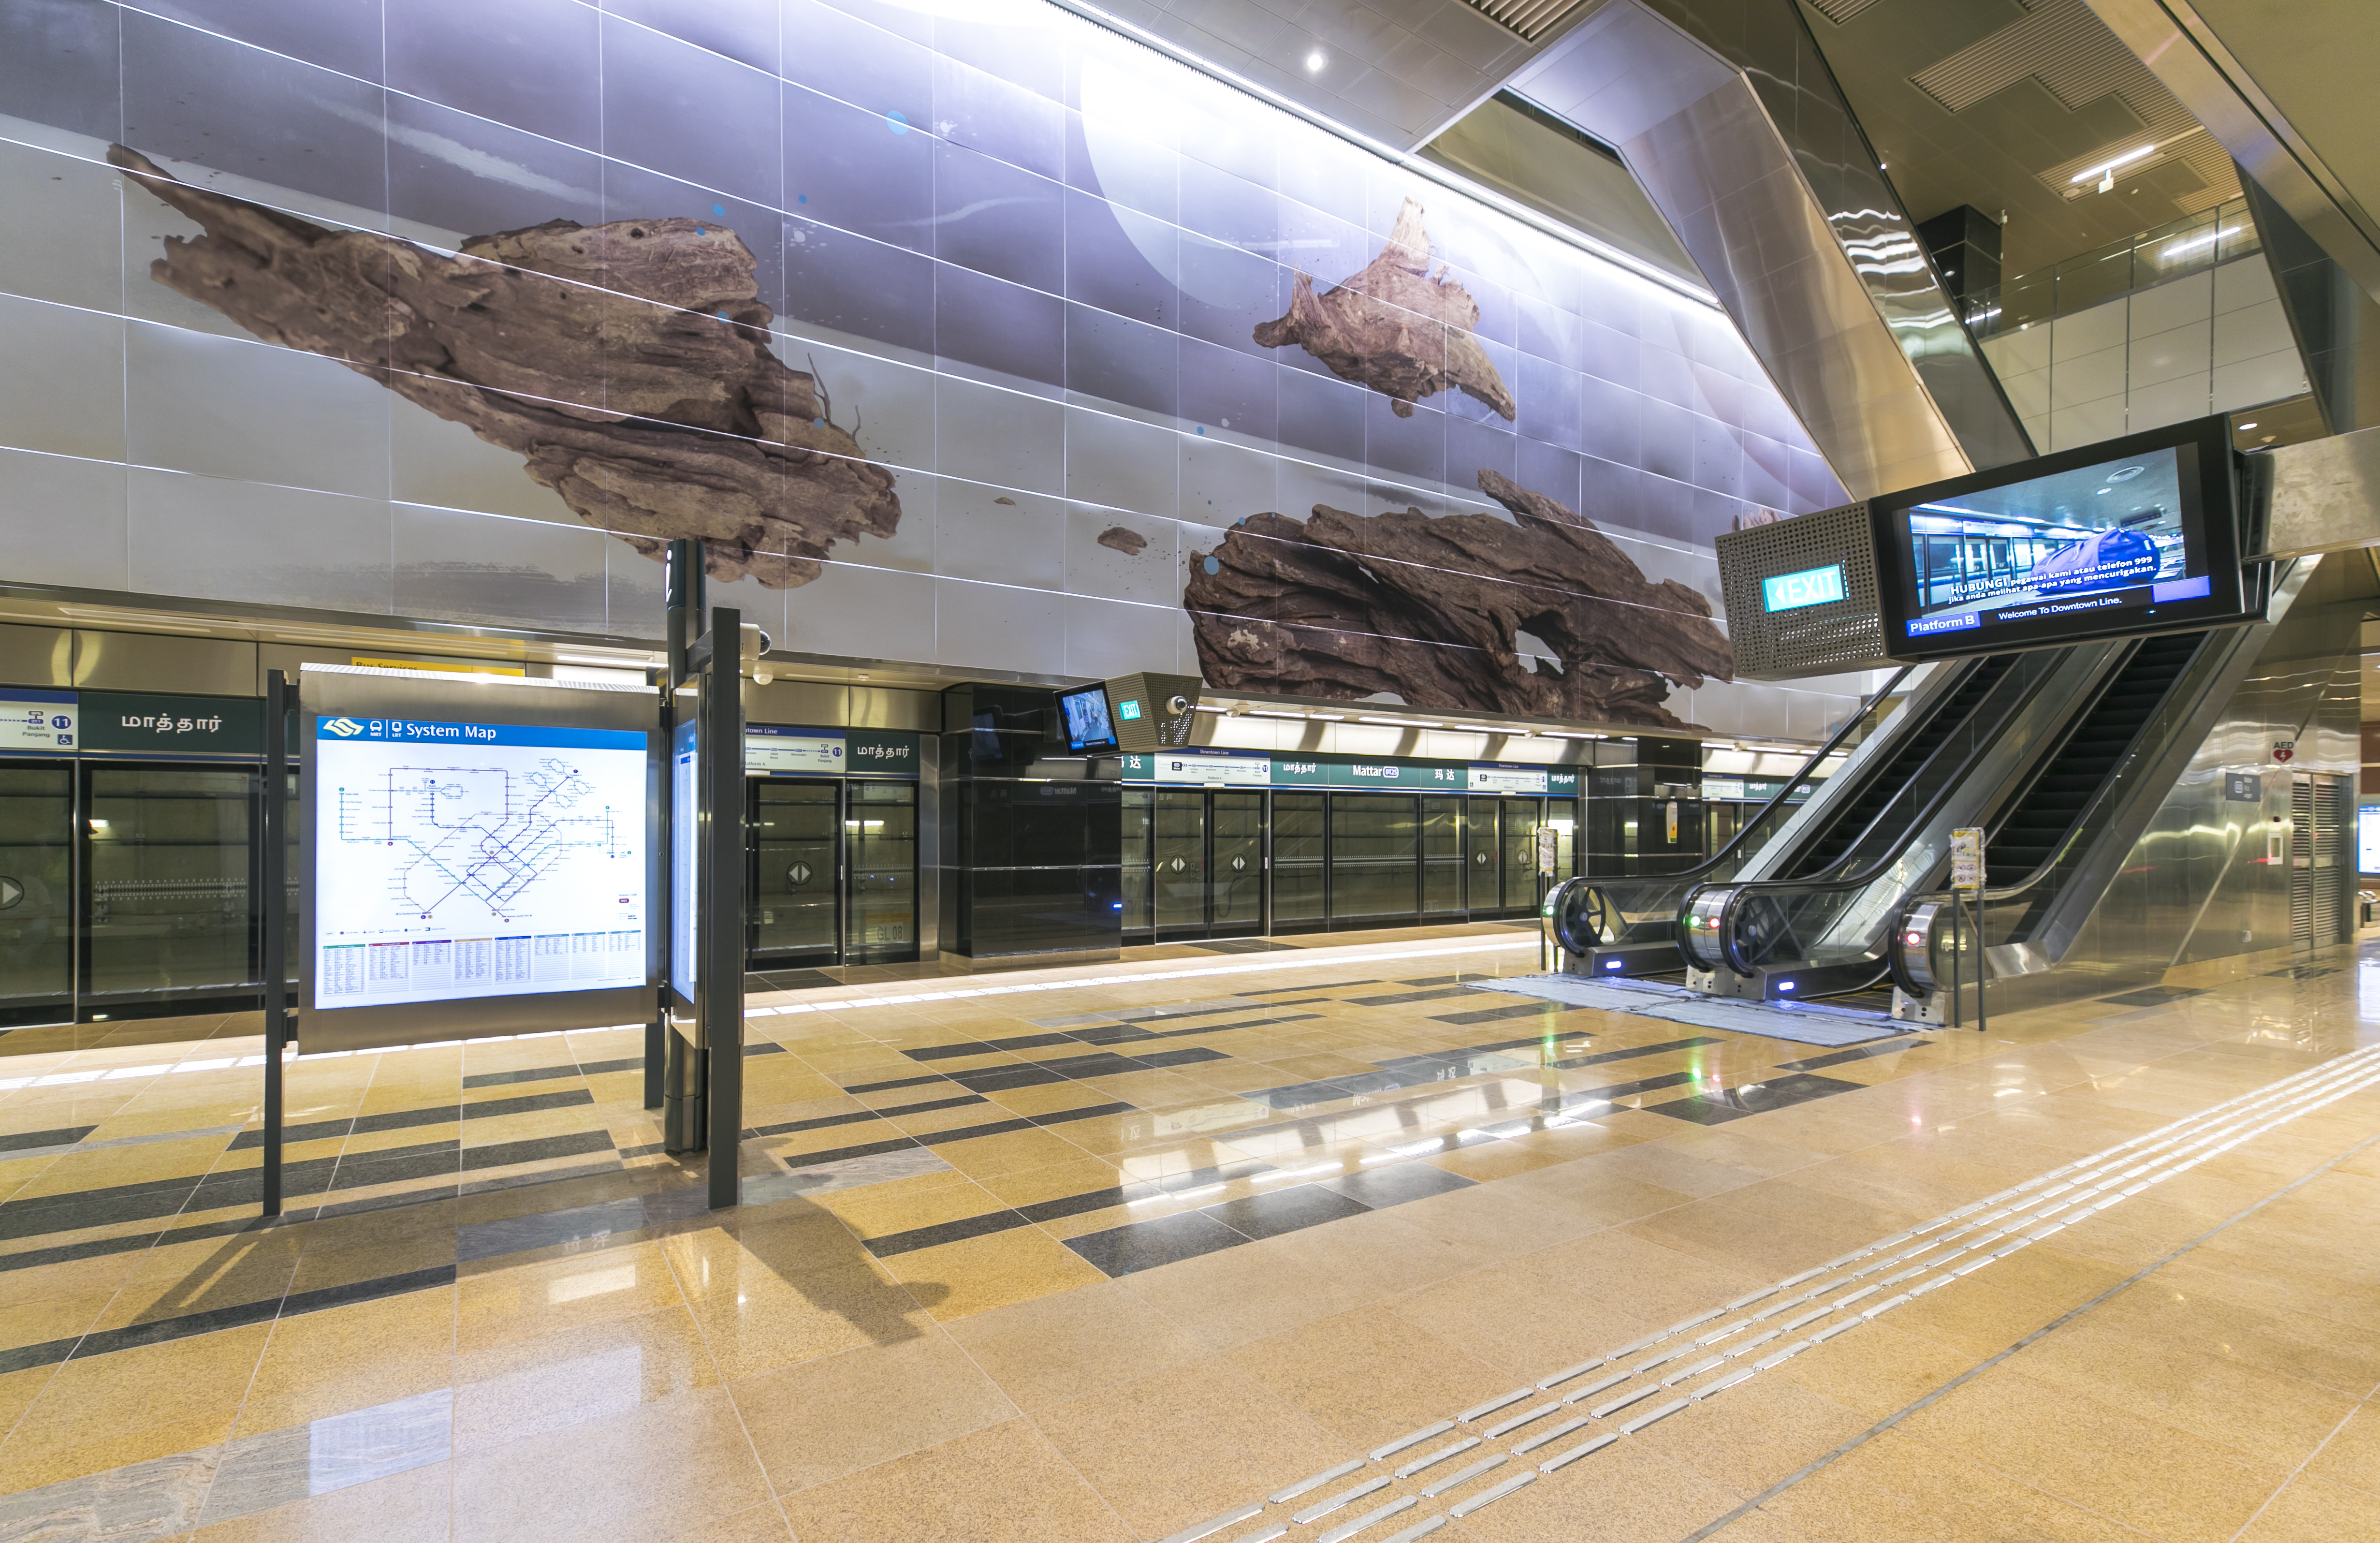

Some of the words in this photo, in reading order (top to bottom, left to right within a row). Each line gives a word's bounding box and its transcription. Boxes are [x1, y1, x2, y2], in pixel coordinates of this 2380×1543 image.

[1951, 578, 2007, 595] HUBUNGI
[2011, 574, 2046, 587] pegawai
[2049, 570, 2071, 579] kami
[2073, 567, 2095, 575] atau
[2097, 560, 2132, 571] telefon
[2134, 556, 2152, 565] 999
[1787, 571, 1836, 604] EXIT
[1948, 596, 1963, 604] jika
[1988, 586, 2021, 597] melihat
[2022, 581, 2058, 592] apa-apa
[2059, 577, 2082, 587] yang
[2084, 566, 2157, 582] mencurigakan.
[1998, 609, 2037, 620] Welcome
[2051, 601, 2097, 612] Downtown
[2099, 597, 2122, 606] Line.
[1910, 619, 1963, 632] Platform
[1965, 615, 1975, 625] B
[1123, 704, 1138, 717] EXIT
[54, 718, 68, 726] 11
[122, 713, 222, 734] மாத்தார்
[407, 723, 459, 738] System
[465, 726, 496, 741] Map
[857, 744, 910, 759] மாத்தார்
[1283, 762, 1316, 774] மாத்தார்
[1353, 764, 1383, 777] Mattar
[877, 926, 890, 941] GL
[892, 925, 903, 940] 08
